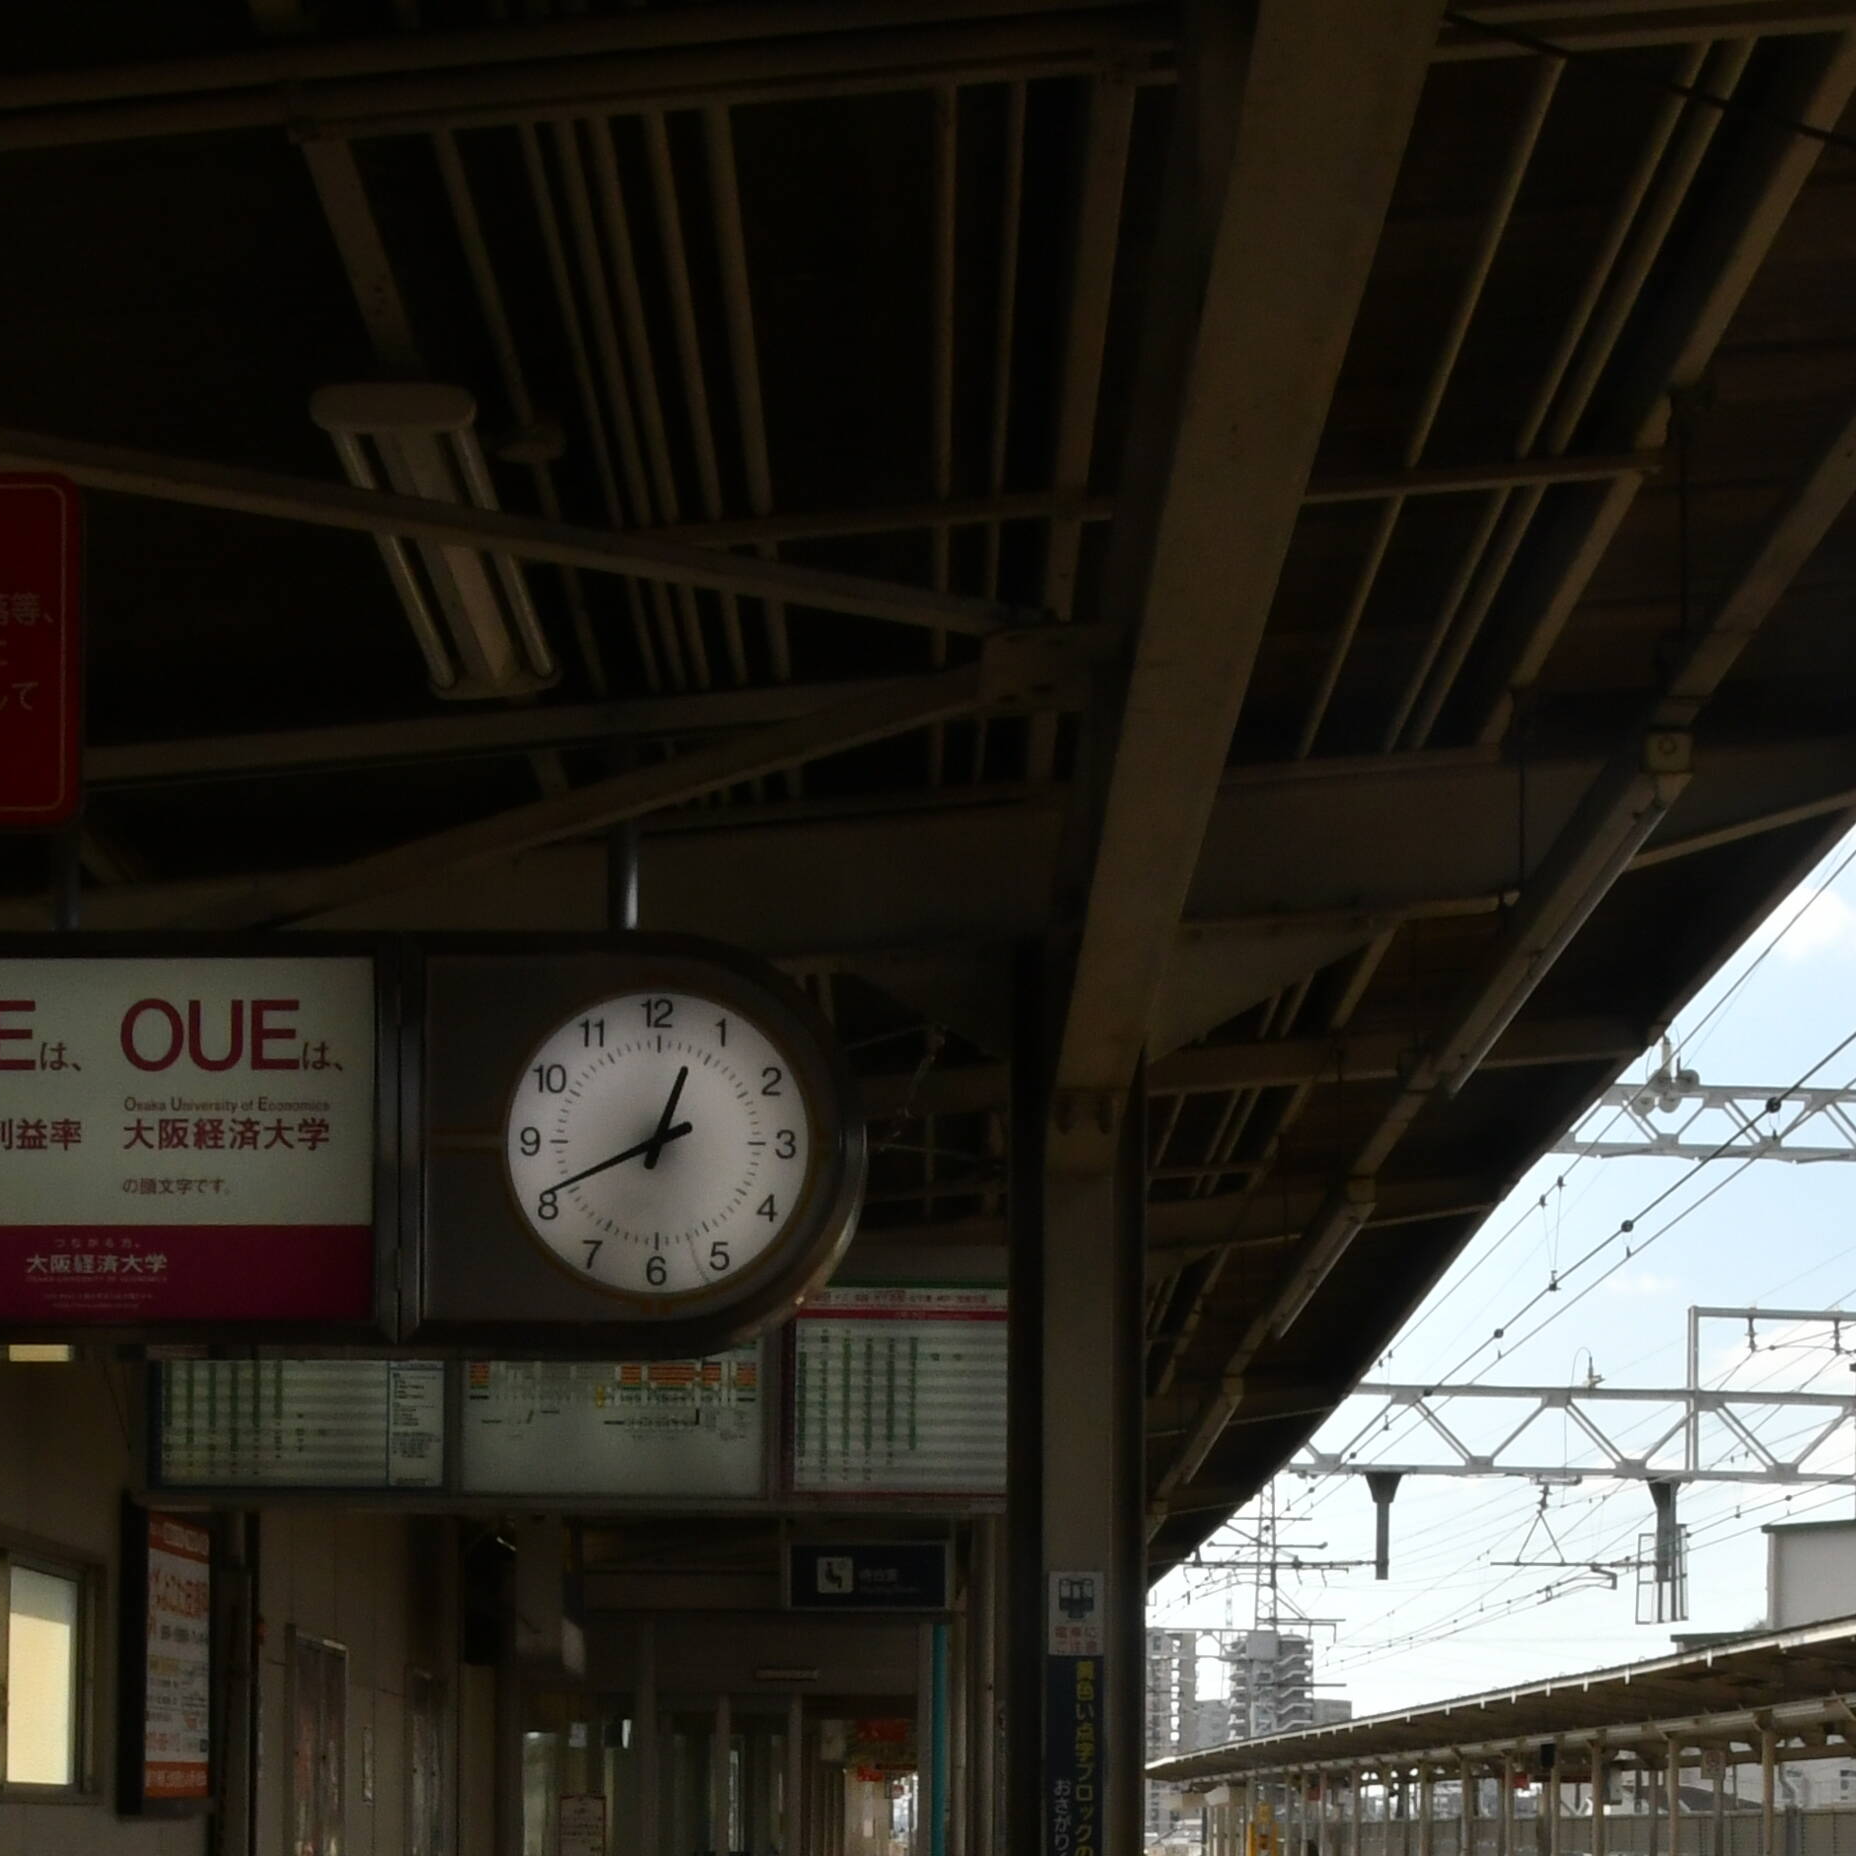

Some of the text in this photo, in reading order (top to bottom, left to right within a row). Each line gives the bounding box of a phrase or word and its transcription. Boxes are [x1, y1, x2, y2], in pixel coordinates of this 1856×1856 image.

[641, 999, 674, 1030] 12
[579, 1018, 605, 1048] 11
[715, 1018, 727, 1047] 1
[533, 1063, 567, 1095] 10
[761, 1067, 782, 1097] 2
[124, 1097, 331, 1115] Osaka University of Economics
[122, 1118, 331, 1152] 大阪経済大学
[519, 1127, 541, 1157] 9
[775, 1129, 796, 1159] 3
[537, 1190, 559, 1221] 8
[756, 1194, 778, 1223] 4
[26, 1253, 168, 1274] 大阪経済大学
[582, 1240, 603, 1269] 7
[709, 1241, 730, 1271] 5
[646, 1256, 667, 1286] 6
